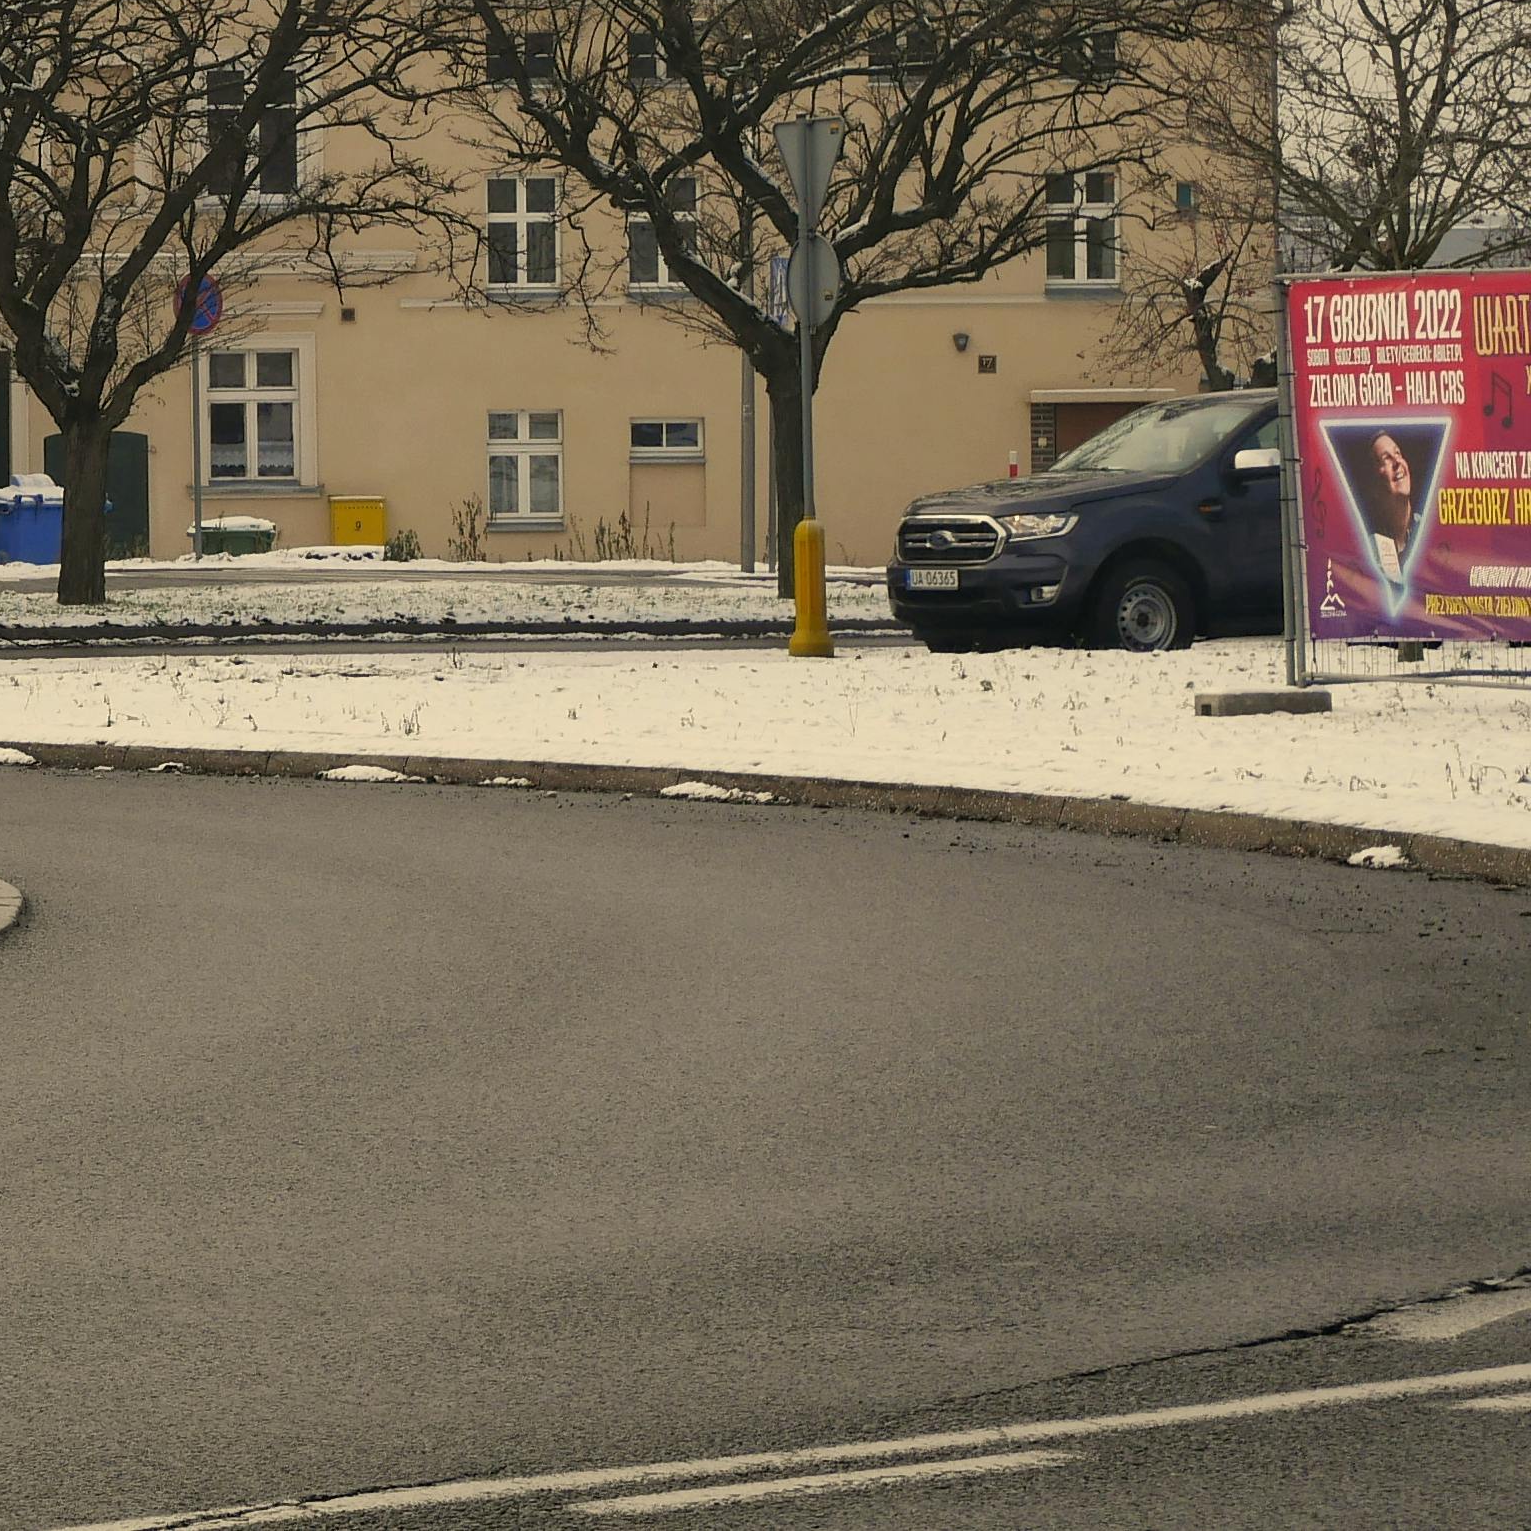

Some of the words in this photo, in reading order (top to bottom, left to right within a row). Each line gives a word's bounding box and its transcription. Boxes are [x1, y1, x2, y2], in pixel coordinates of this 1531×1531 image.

[1304, 295, 1326, 343] 17
[1329, 292, 1410, 343] GRUDNIA
[1414, 289, 1462, 340] 2022
[1308, 373, 1358, 407] ZIELONA
[1359, 364, 1394, 406] GÓRA
[1405, 370, 1439, 405] HALA
[1440, 370, 1466, 405] CRS
[1455, 451, 1470, 480] NA
[1471, 451, 1518, 480] KONCERT
[1438, 487, 1512, 525] GRZEGORZ
[926, 570, 956, 586] 06365
